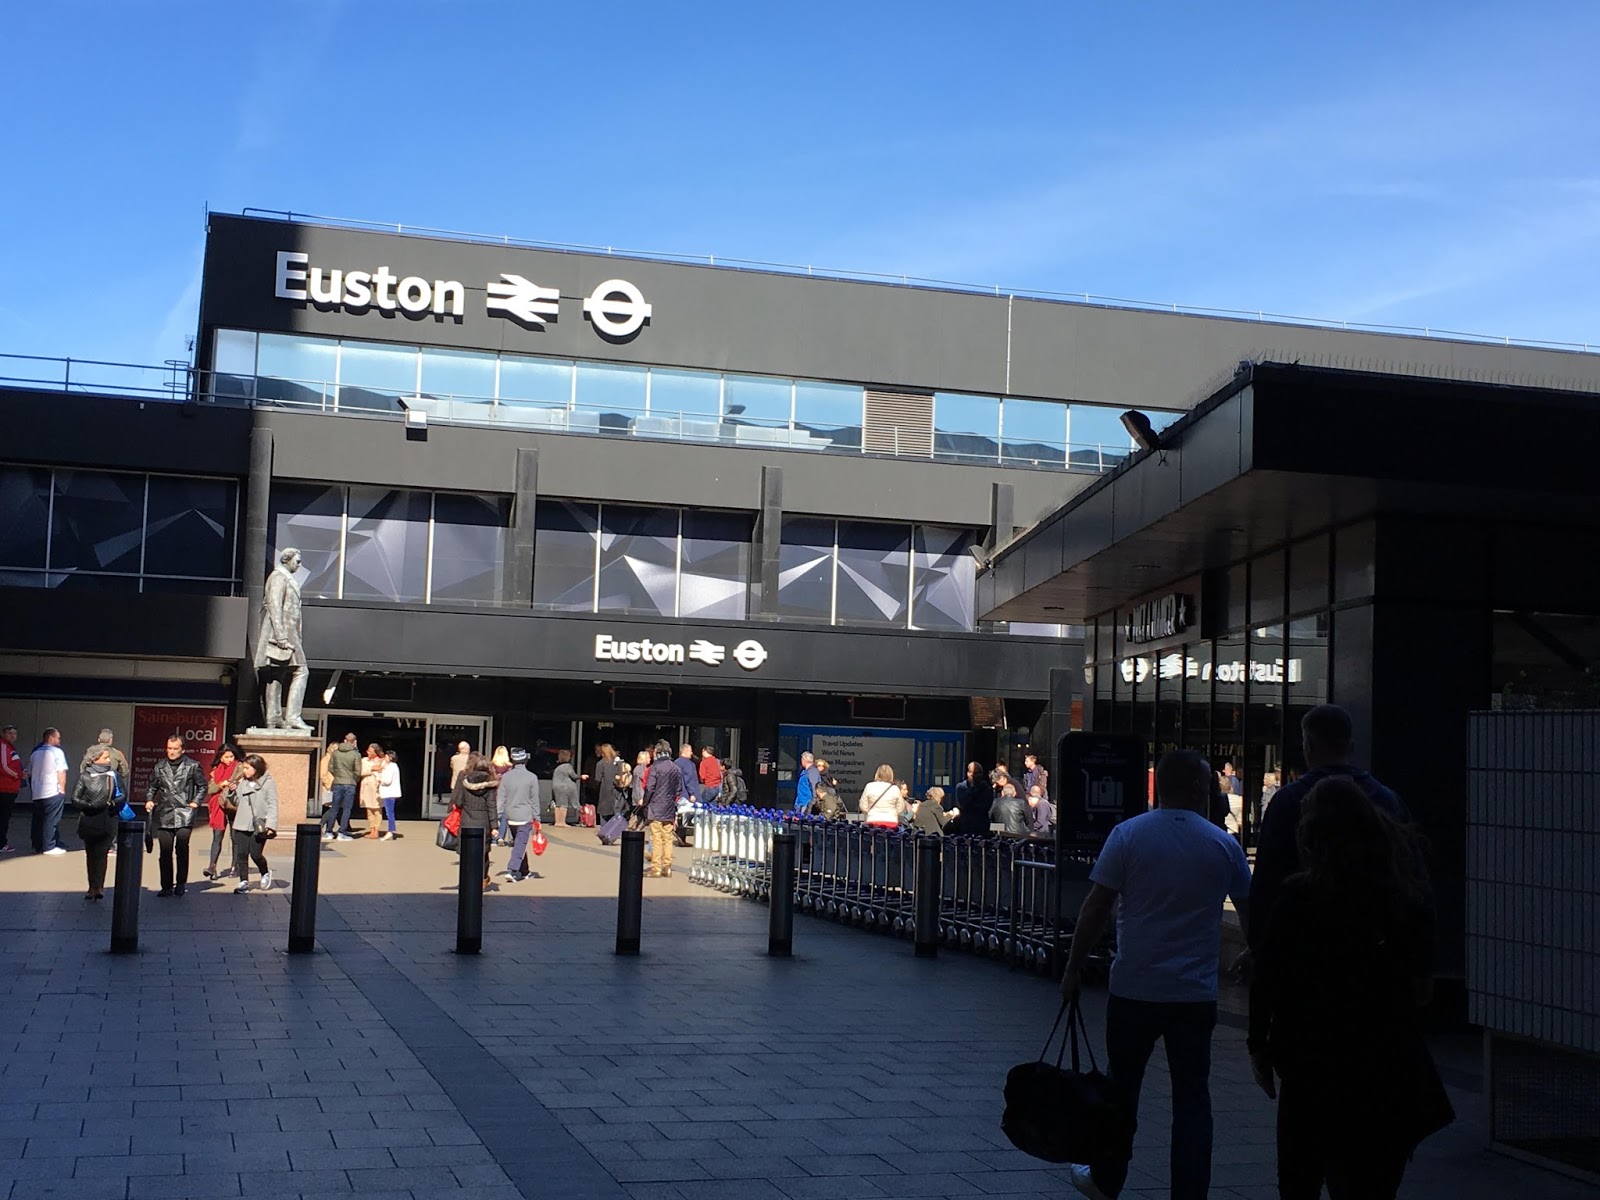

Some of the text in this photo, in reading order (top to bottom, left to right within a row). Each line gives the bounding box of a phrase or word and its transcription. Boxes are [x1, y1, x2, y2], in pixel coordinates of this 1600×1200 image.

[275, 250, 465, 316] Euston
[594, 634, 684, 662] Euston
[138, 710, 218, 726] Sainsbury's
